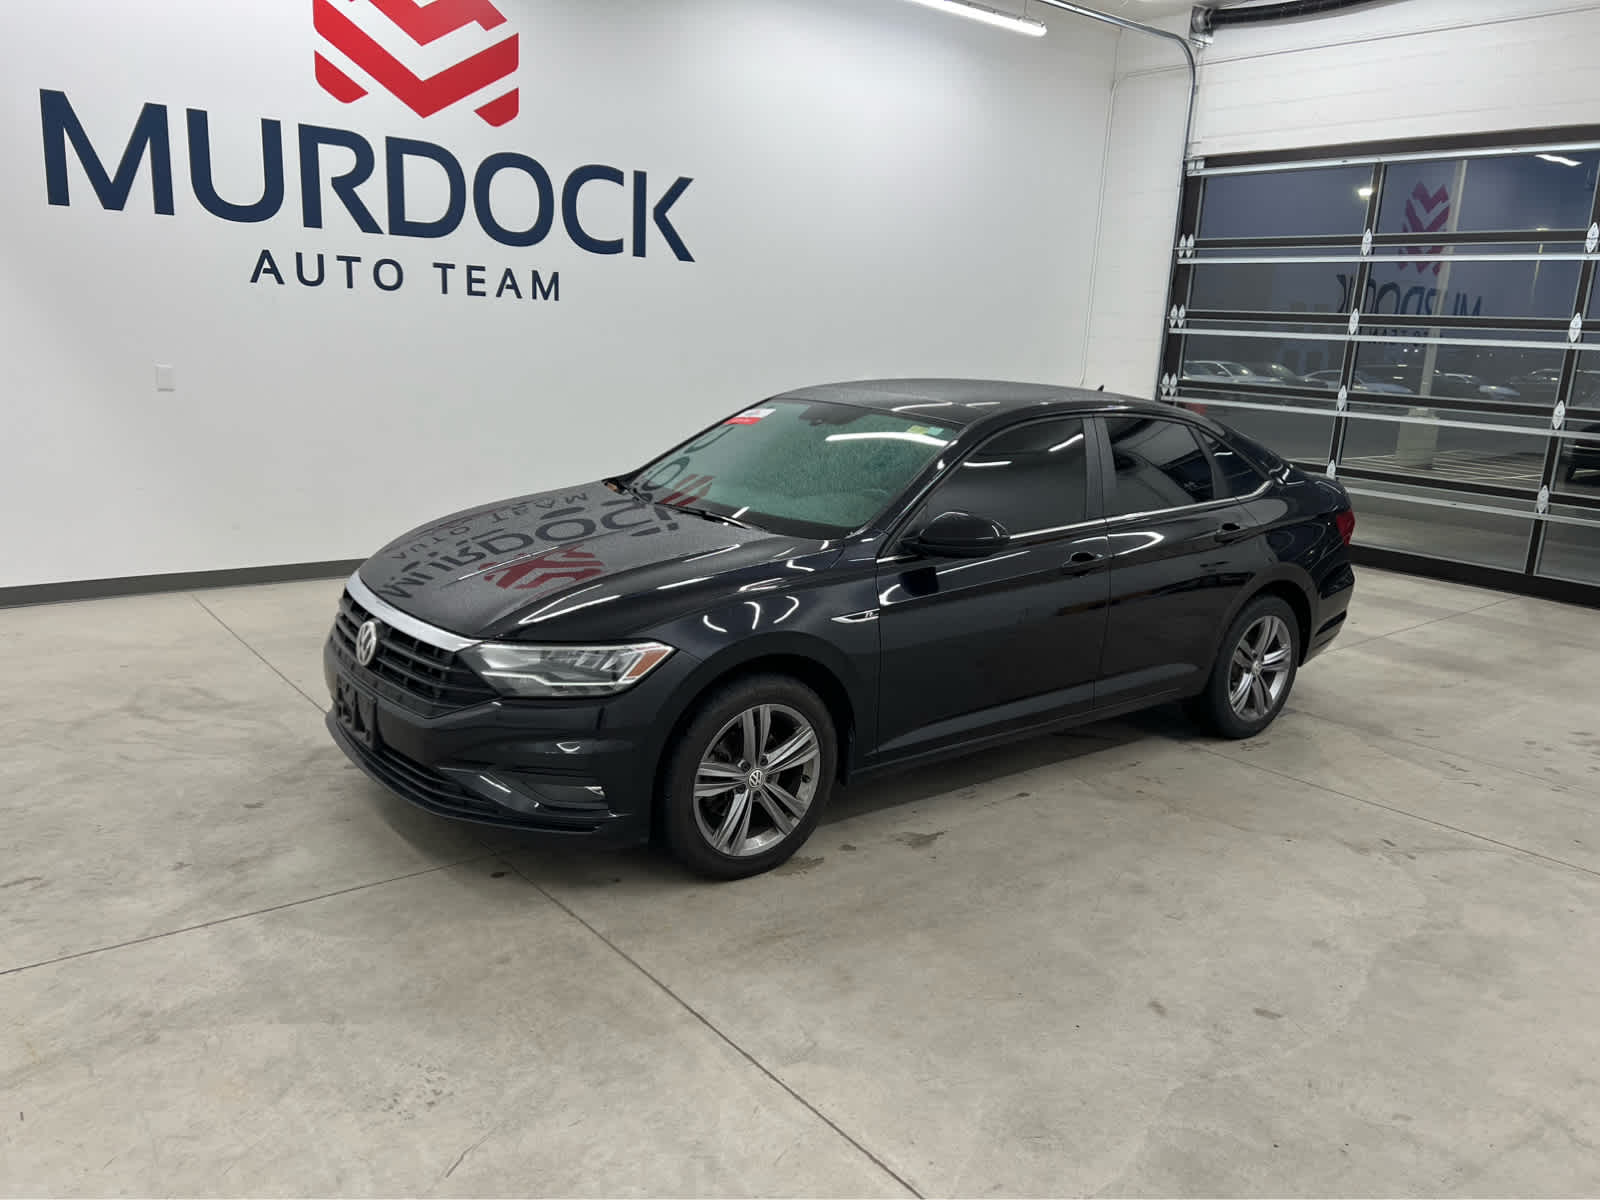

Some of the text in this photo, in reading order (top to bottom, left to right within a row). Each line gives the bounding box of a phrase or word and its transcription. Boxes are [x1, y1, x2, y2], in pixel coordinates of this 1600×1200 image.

[39, 88, 696, 263] MURDOCK
[250, 249, 561, 302] AUTO TEAM
